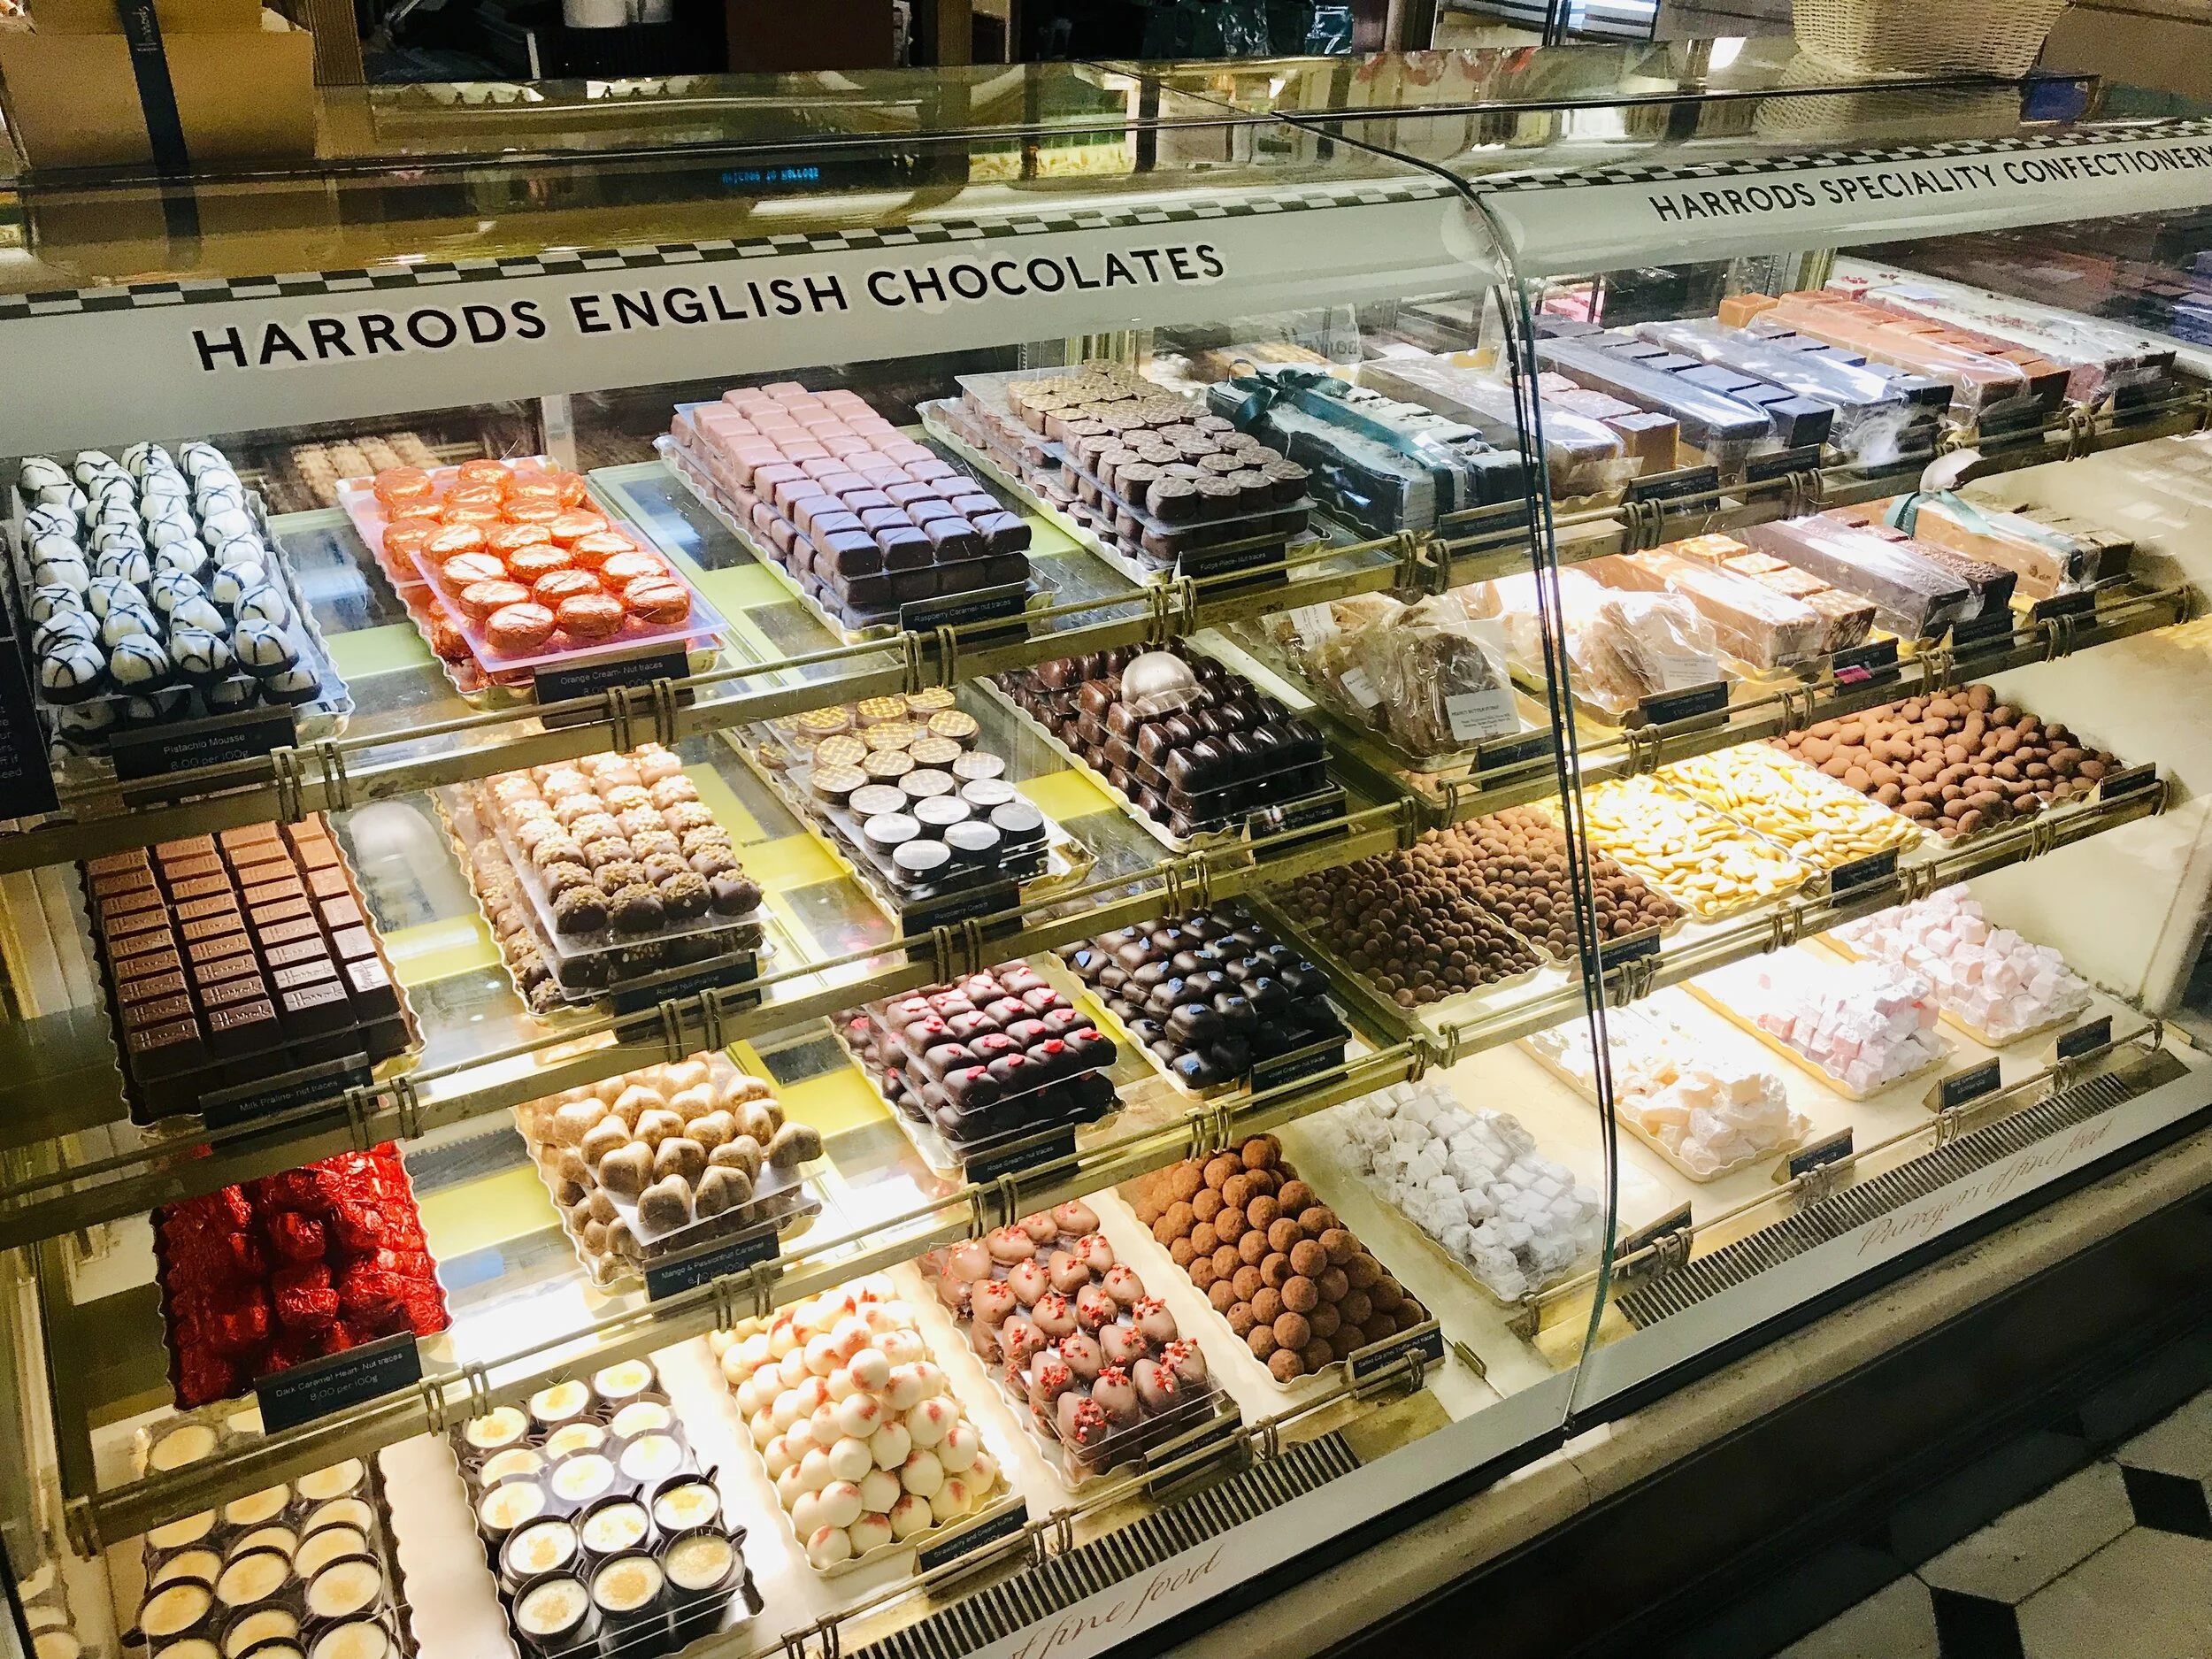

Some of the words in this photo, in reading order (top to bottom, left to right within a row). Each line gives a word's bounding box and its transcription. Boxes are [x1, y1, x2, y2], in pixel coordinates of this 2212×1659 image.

[1647, 182, 1815, 221] HARRODS
[1820, 165, 1997, 204] SPECIALITY
[2003, 145, 2212, 184] CONFECTIONERY
[193, 301, 546, 371] HARRODS
[570, 276, 848, 333] ENGLISH
[867, 245, 1224, 306] CHOCOLATES
[914, 612, 948, 622] Raspberry
[560, 675, 590, 685] Orange
[639, 661, 663, 672] traces
[163, 741, 207, 755] Pistachio
[209, 733, 245, 746] Mousse
[202, 756, 219, 766] per
[223, 749, 249, 761] 100g
[934, 908, 965, 919] Raspberry
[288, 987, 343, 1007] Harrods
[240, 1102, 257, 1111] Milk
[296, 1088, 310, 1097] nut
[311, 1081, 338, 1092] traces
[661, 1267, 686, 1279] Mango
[735, 1241, 764, 1256] Caramel
[276, 1386, 296, 1397] Dark
[298, 1375, 333, 1390] Caramel
[378, 1353, 403, 1364] traces
[310, 1388, 334, 1401] 8.00
[336, 1383, 352, 1394] per
[355, 1374, 378, 1387] 100g
[933, 1540, 965, 1558] Strawberry
[978, 1524, 997, 1536] Cream
[1039, 1601, 1125, 1659] fine
[1121, 1543, 1225, 1628] food
